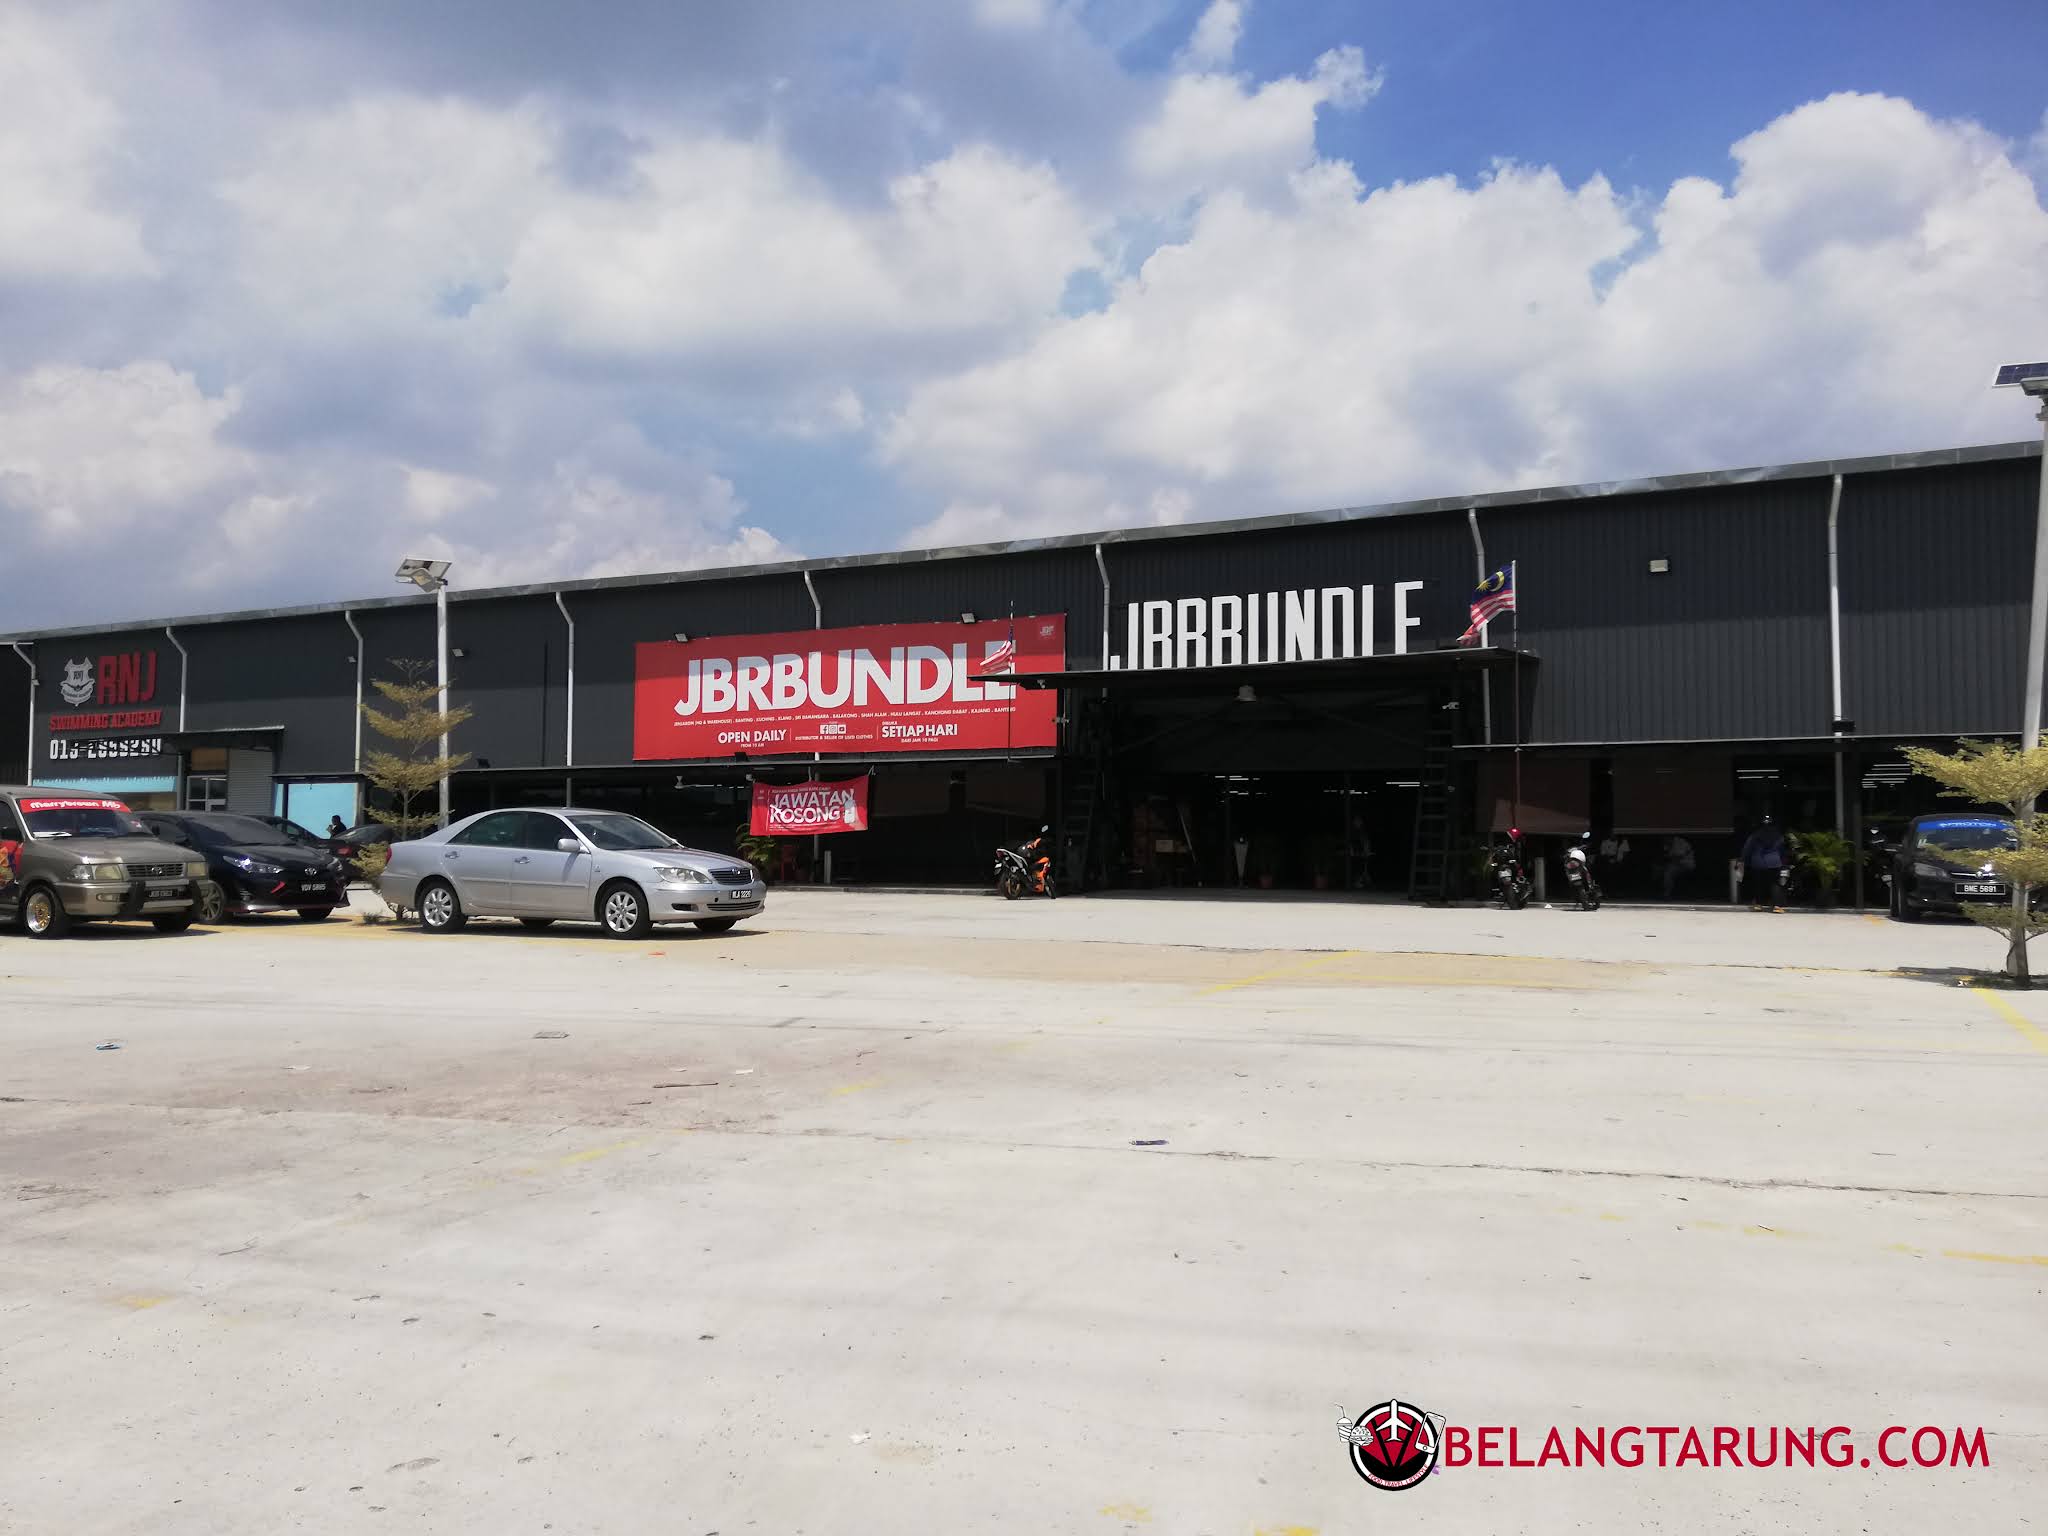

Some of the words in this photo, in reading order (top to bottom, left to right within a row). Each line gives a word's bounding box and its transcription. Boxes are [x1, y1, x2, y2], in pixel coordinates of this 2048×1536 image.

[97, 651, 157, 705] RNJ
[673, 639, 1017, 716] JBRBUNDLE
[49, 713, 109, 732] SWIMMING
[110, 710, 162, 728] ACADEMY
[882, 725, 924, 738] SETIAP
[925, 724, 958, 737] HARI
[718, 731, 750, 744] OPEN
[754, 729, 787, 742] DAILY
[774, 788, 855, 809] JAWATAN
[770, 805, 840, 824] KOSONG
[1964, 884, 1978, 892] BME
